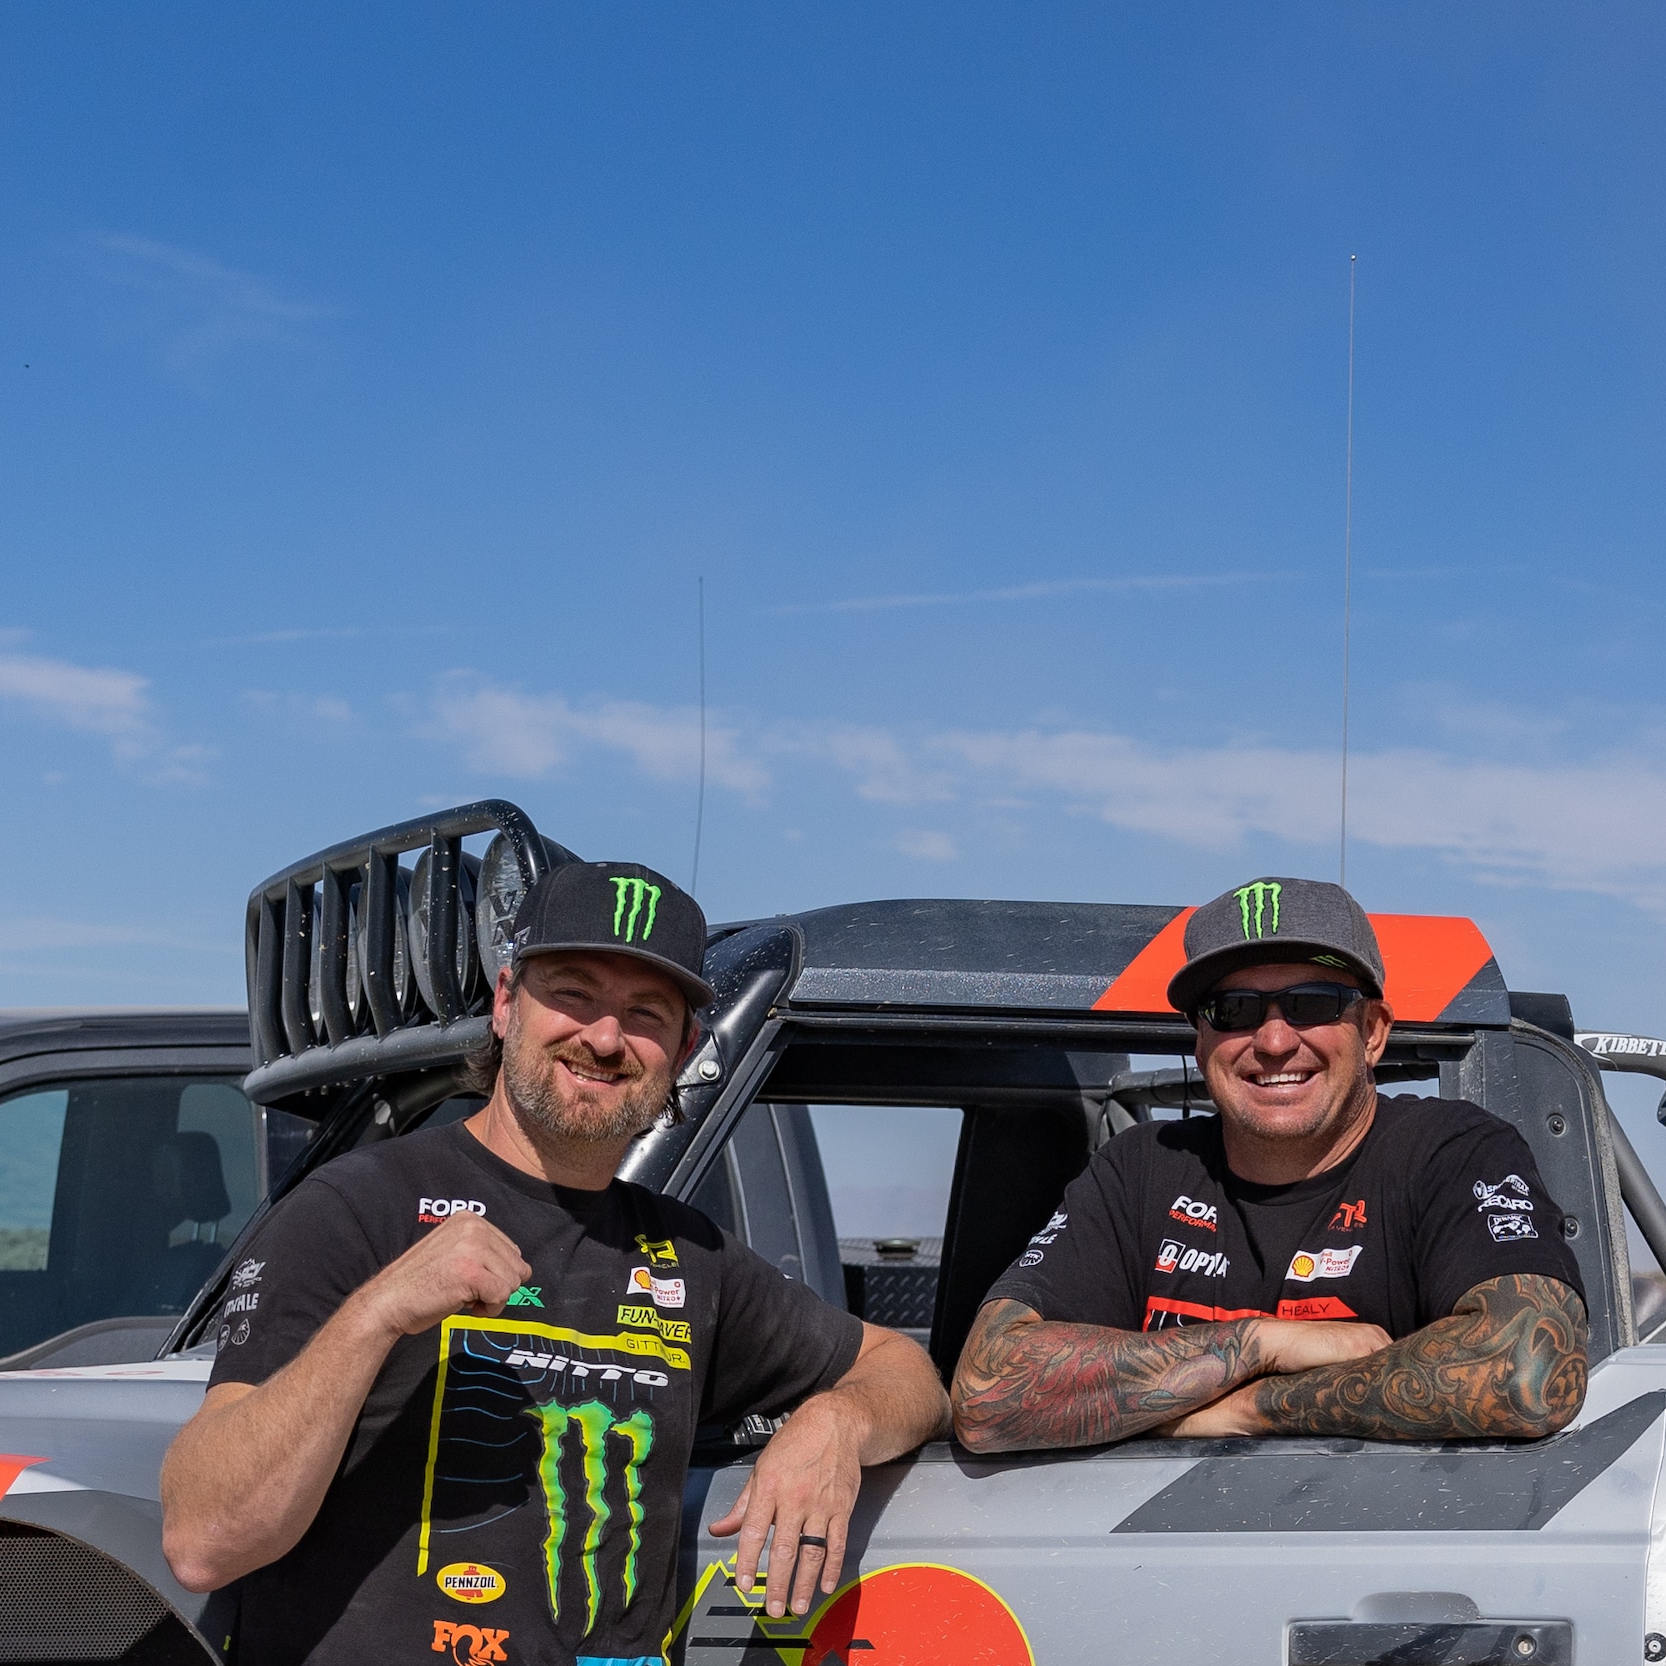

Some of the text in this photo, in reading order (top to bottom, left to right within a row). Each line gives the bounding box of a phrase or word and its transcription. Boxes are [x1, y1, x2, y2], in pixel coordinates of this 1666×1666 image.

[1282, 1303, 1330, 1317] HEALY
[505, 1350, 670, 1388] NITTO
[444, 1575, 497, 1589] PENNZOIL
